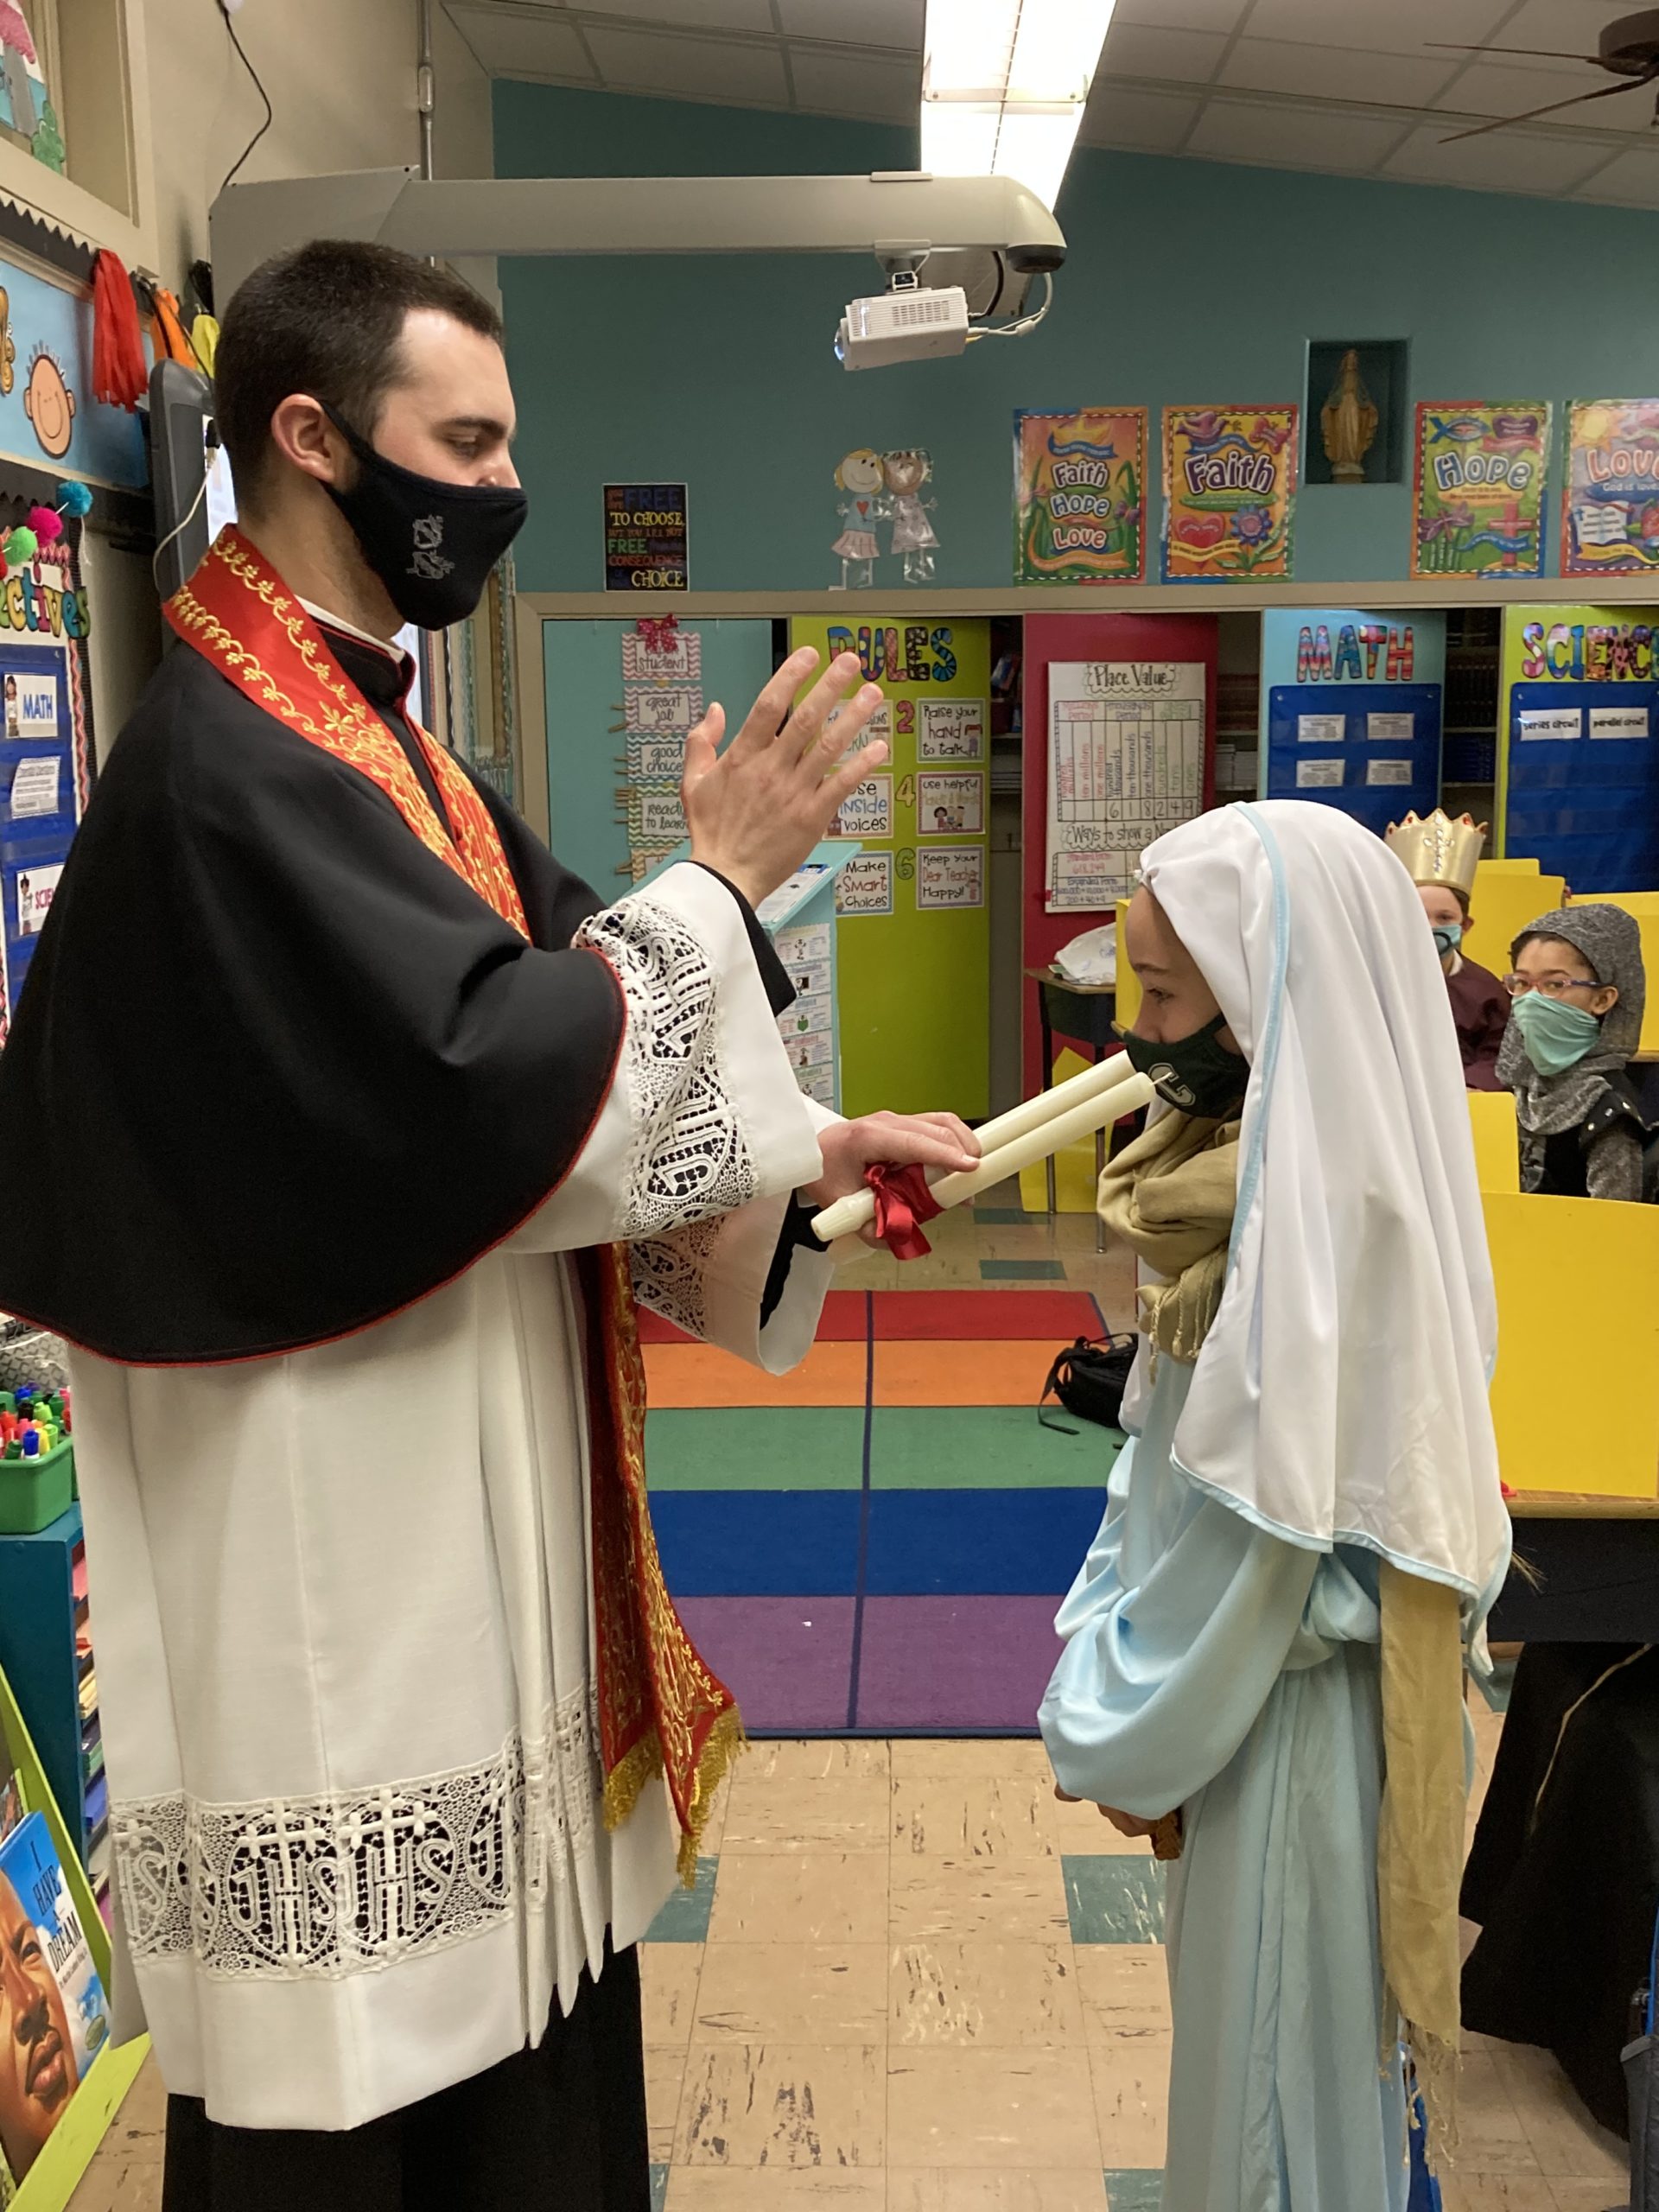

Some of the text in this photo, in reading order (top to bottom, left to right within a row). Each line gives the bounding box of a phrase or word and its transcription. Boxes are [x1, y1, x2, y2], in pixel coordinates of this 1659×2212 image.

[1052, 459, 1109, 489] Faith
[1185, 450, 1275, 495] Faith
[1433, 451, 1532, 491] Hope
[1050, 493, 1110, 519] Hope
[609, 512, 630, 526] TO
[607, 538, 648, 554] FREE
[1052, 527, 1107, 550] Love
[631, 567, 683, 588] CHOICE
[639, 654, 686, 672] student
[1297, 624, 1414, 683] MATH
[1094, 664, 1167, 687] Place Value
[22, 694, 54, 720] MATH
[645, 692, 683, 712] great
[896, 699, 916, 734] 2
[923, 705, 979, 721] Raise your
[928, 721, 962, 740] hand
[651, 741, 683, 761] good
[923, 742, 935, 756] to
[850, 782, 877, 796] se
[895, 774, 917, 808] 4
[944, 779, 978, 791] helpful
[1109, 802, 1120, 818] 6
[1142, 801, 1152, 817] 8
[1156, 801, 1165, 817] 2
[1170, 801, 1180, 816] 4
[1183, 799, 1194, 817] 9
[645, 817, 657, 829] to
[1071, 824, 1101, 846] Ways
[1116, 823, 1142, 842] show
[1144, 829, 1152, 840] a
[845, 861, 887, 874] Make
[894, 848, 916, 880] 6
[923, 854, 950, 866] Keep
[842, 874, 887, 893] Smart
[922, 868, 943, 883] Dear
[35, 887, 54, 911] SCIE
[844, 895, 888, 908] Choices
[29, 1840, 41, 1872] I
[33, 1864, 62, 1916] HAVE
[54, 1909, 61, 1923] A
[48, 1910, 83, 1974] DREAM
